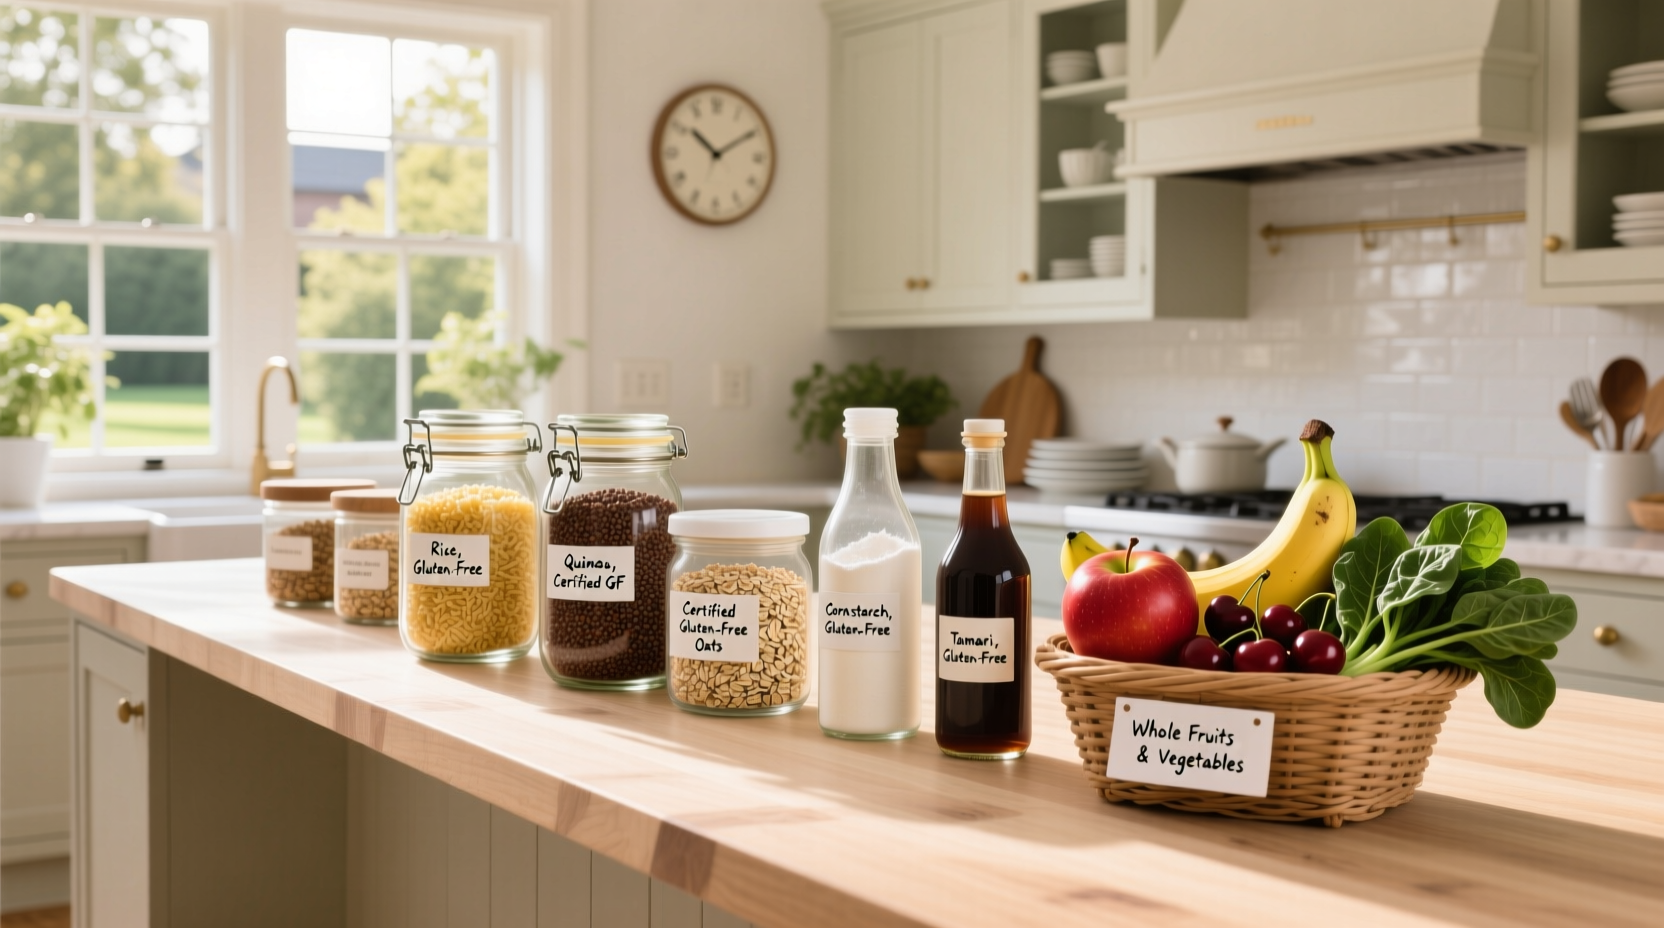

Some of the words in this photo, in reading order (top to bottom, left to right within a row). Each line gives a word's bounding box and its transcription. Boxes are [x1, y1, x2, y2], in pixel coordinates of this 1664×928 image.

[431, 540, 462, 559] Rice,
[564, 553, 616, 573] Quinoa,
[605, 575, 626, 590] GF
[682, 600, 736, 618] Certified
[825, 602, 893, 621] Cornstarch,
[679, 618, 748, 636] Gluten-Free
[695, 637, 723, 653] Oats
[950, 631, 999, 650] Tamari,
[943, 648, 1007, 665] Gluten-Free
[1132, 718, 1181, 741] Whole
[1188, 724, 1235, 746] Fruits
[1136, 744, 1149, 763] &
[1158, 748, 1244, 775] Vegetables
